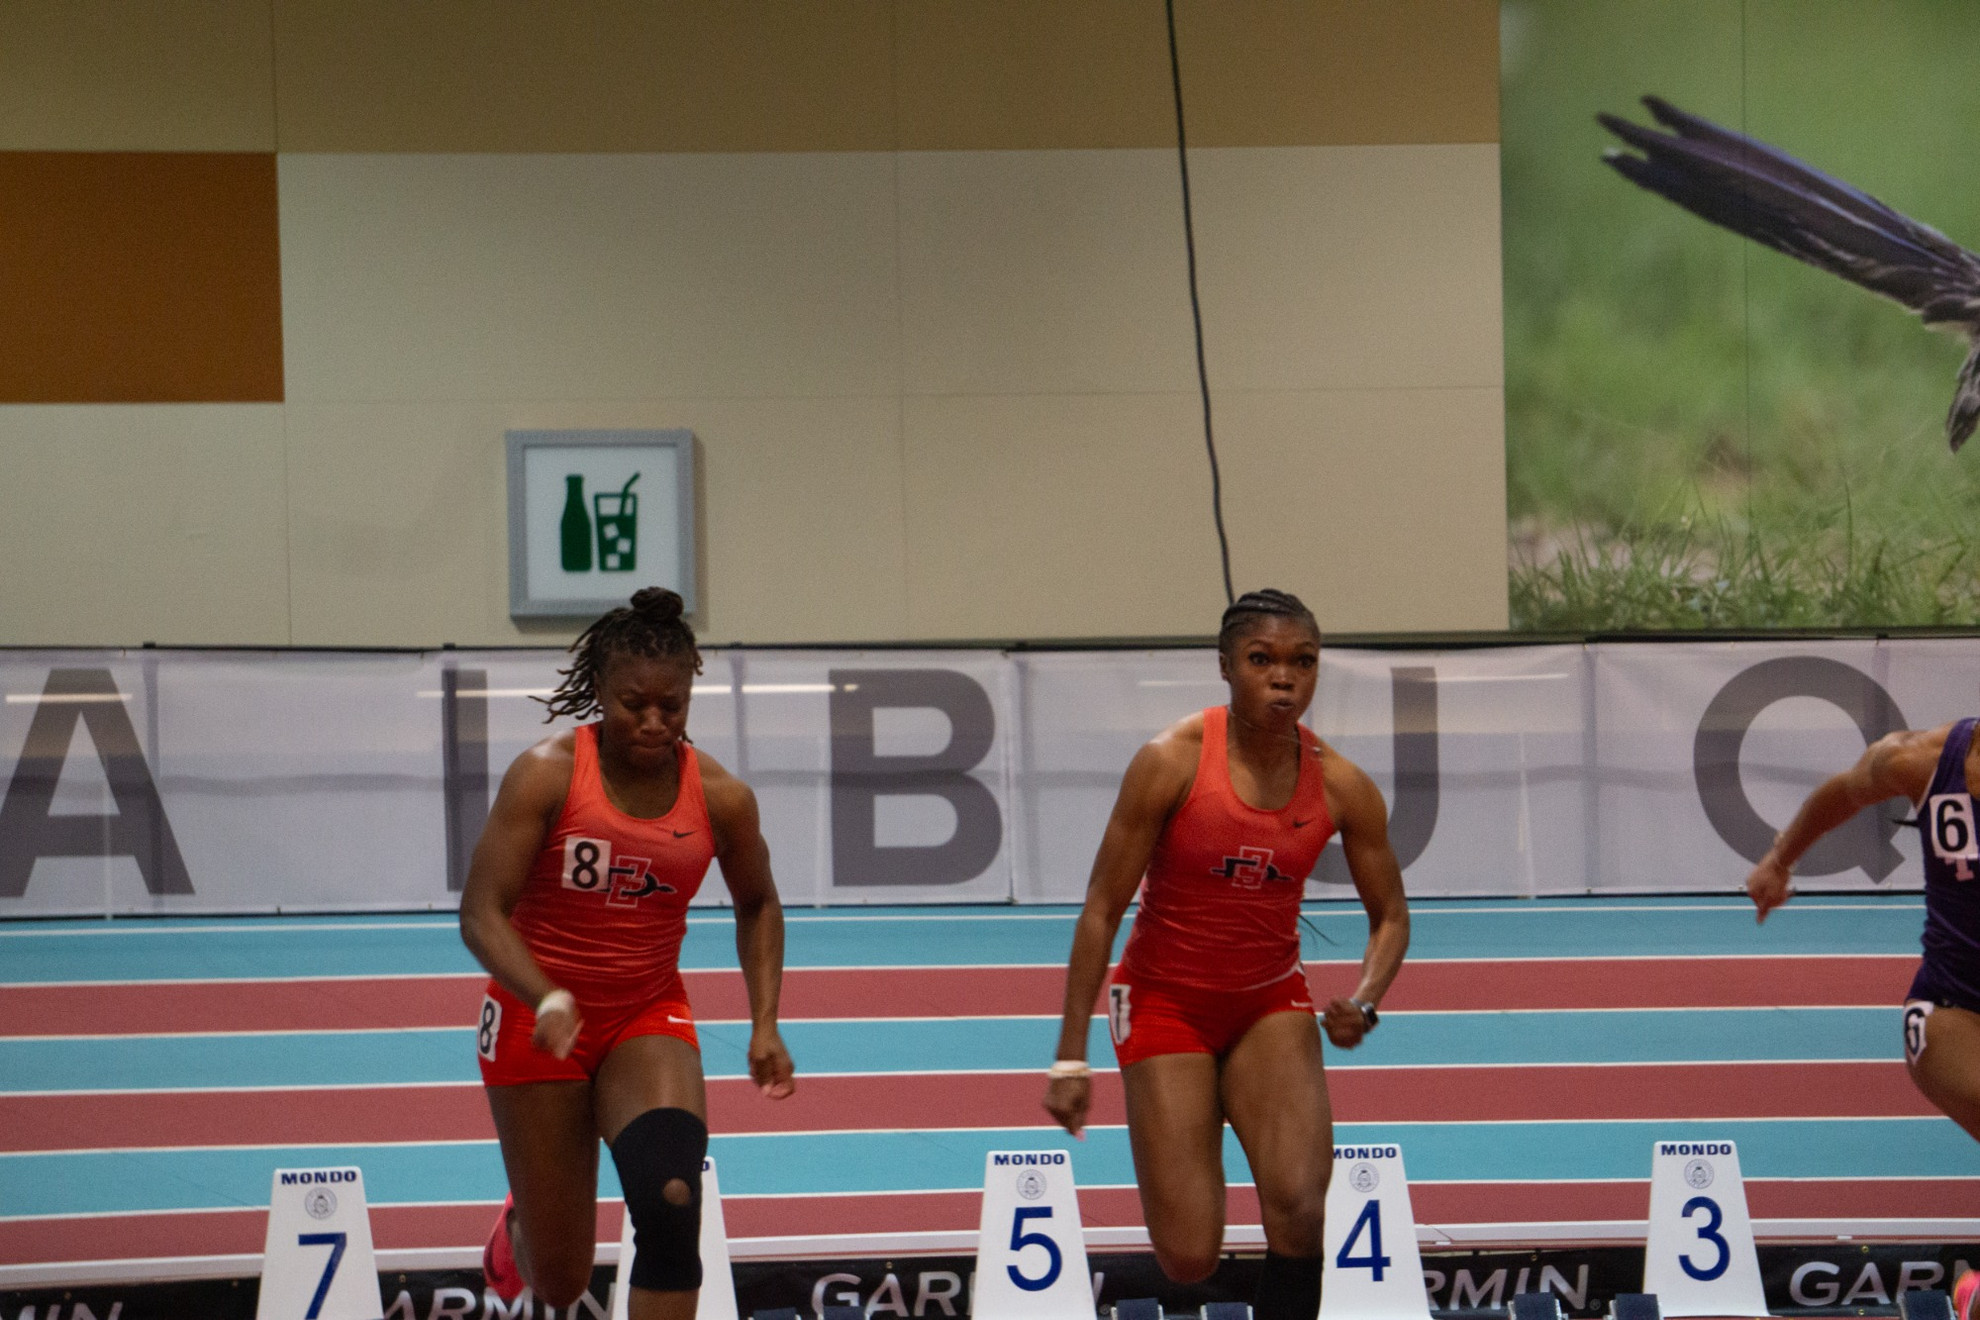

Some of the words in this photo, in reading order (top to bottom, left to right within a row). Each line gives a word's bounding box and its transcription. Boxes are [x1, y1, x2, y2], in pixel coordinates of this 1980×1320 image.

[1936, 799, 1968, 852] 6
[572, 841, 600, 889] 8
[480, 1001, 495, 1055] 8
[1904, 1007, 1925, 1055] 6
[994, 1154, 1065, 1165] MONDO
[1661, 1144, 1732, 1155] MONDO
[281, 1171, 357, 1184] MONDO
[1006, 1206, 1063, 1291] 5
[1336, 1200, 1391, 1282] 4
[1678, 1196, 1730, 1281] 3
[298, 1232, 347, 1320] 7
[1789, 1260, 1970, 1306] GAR
